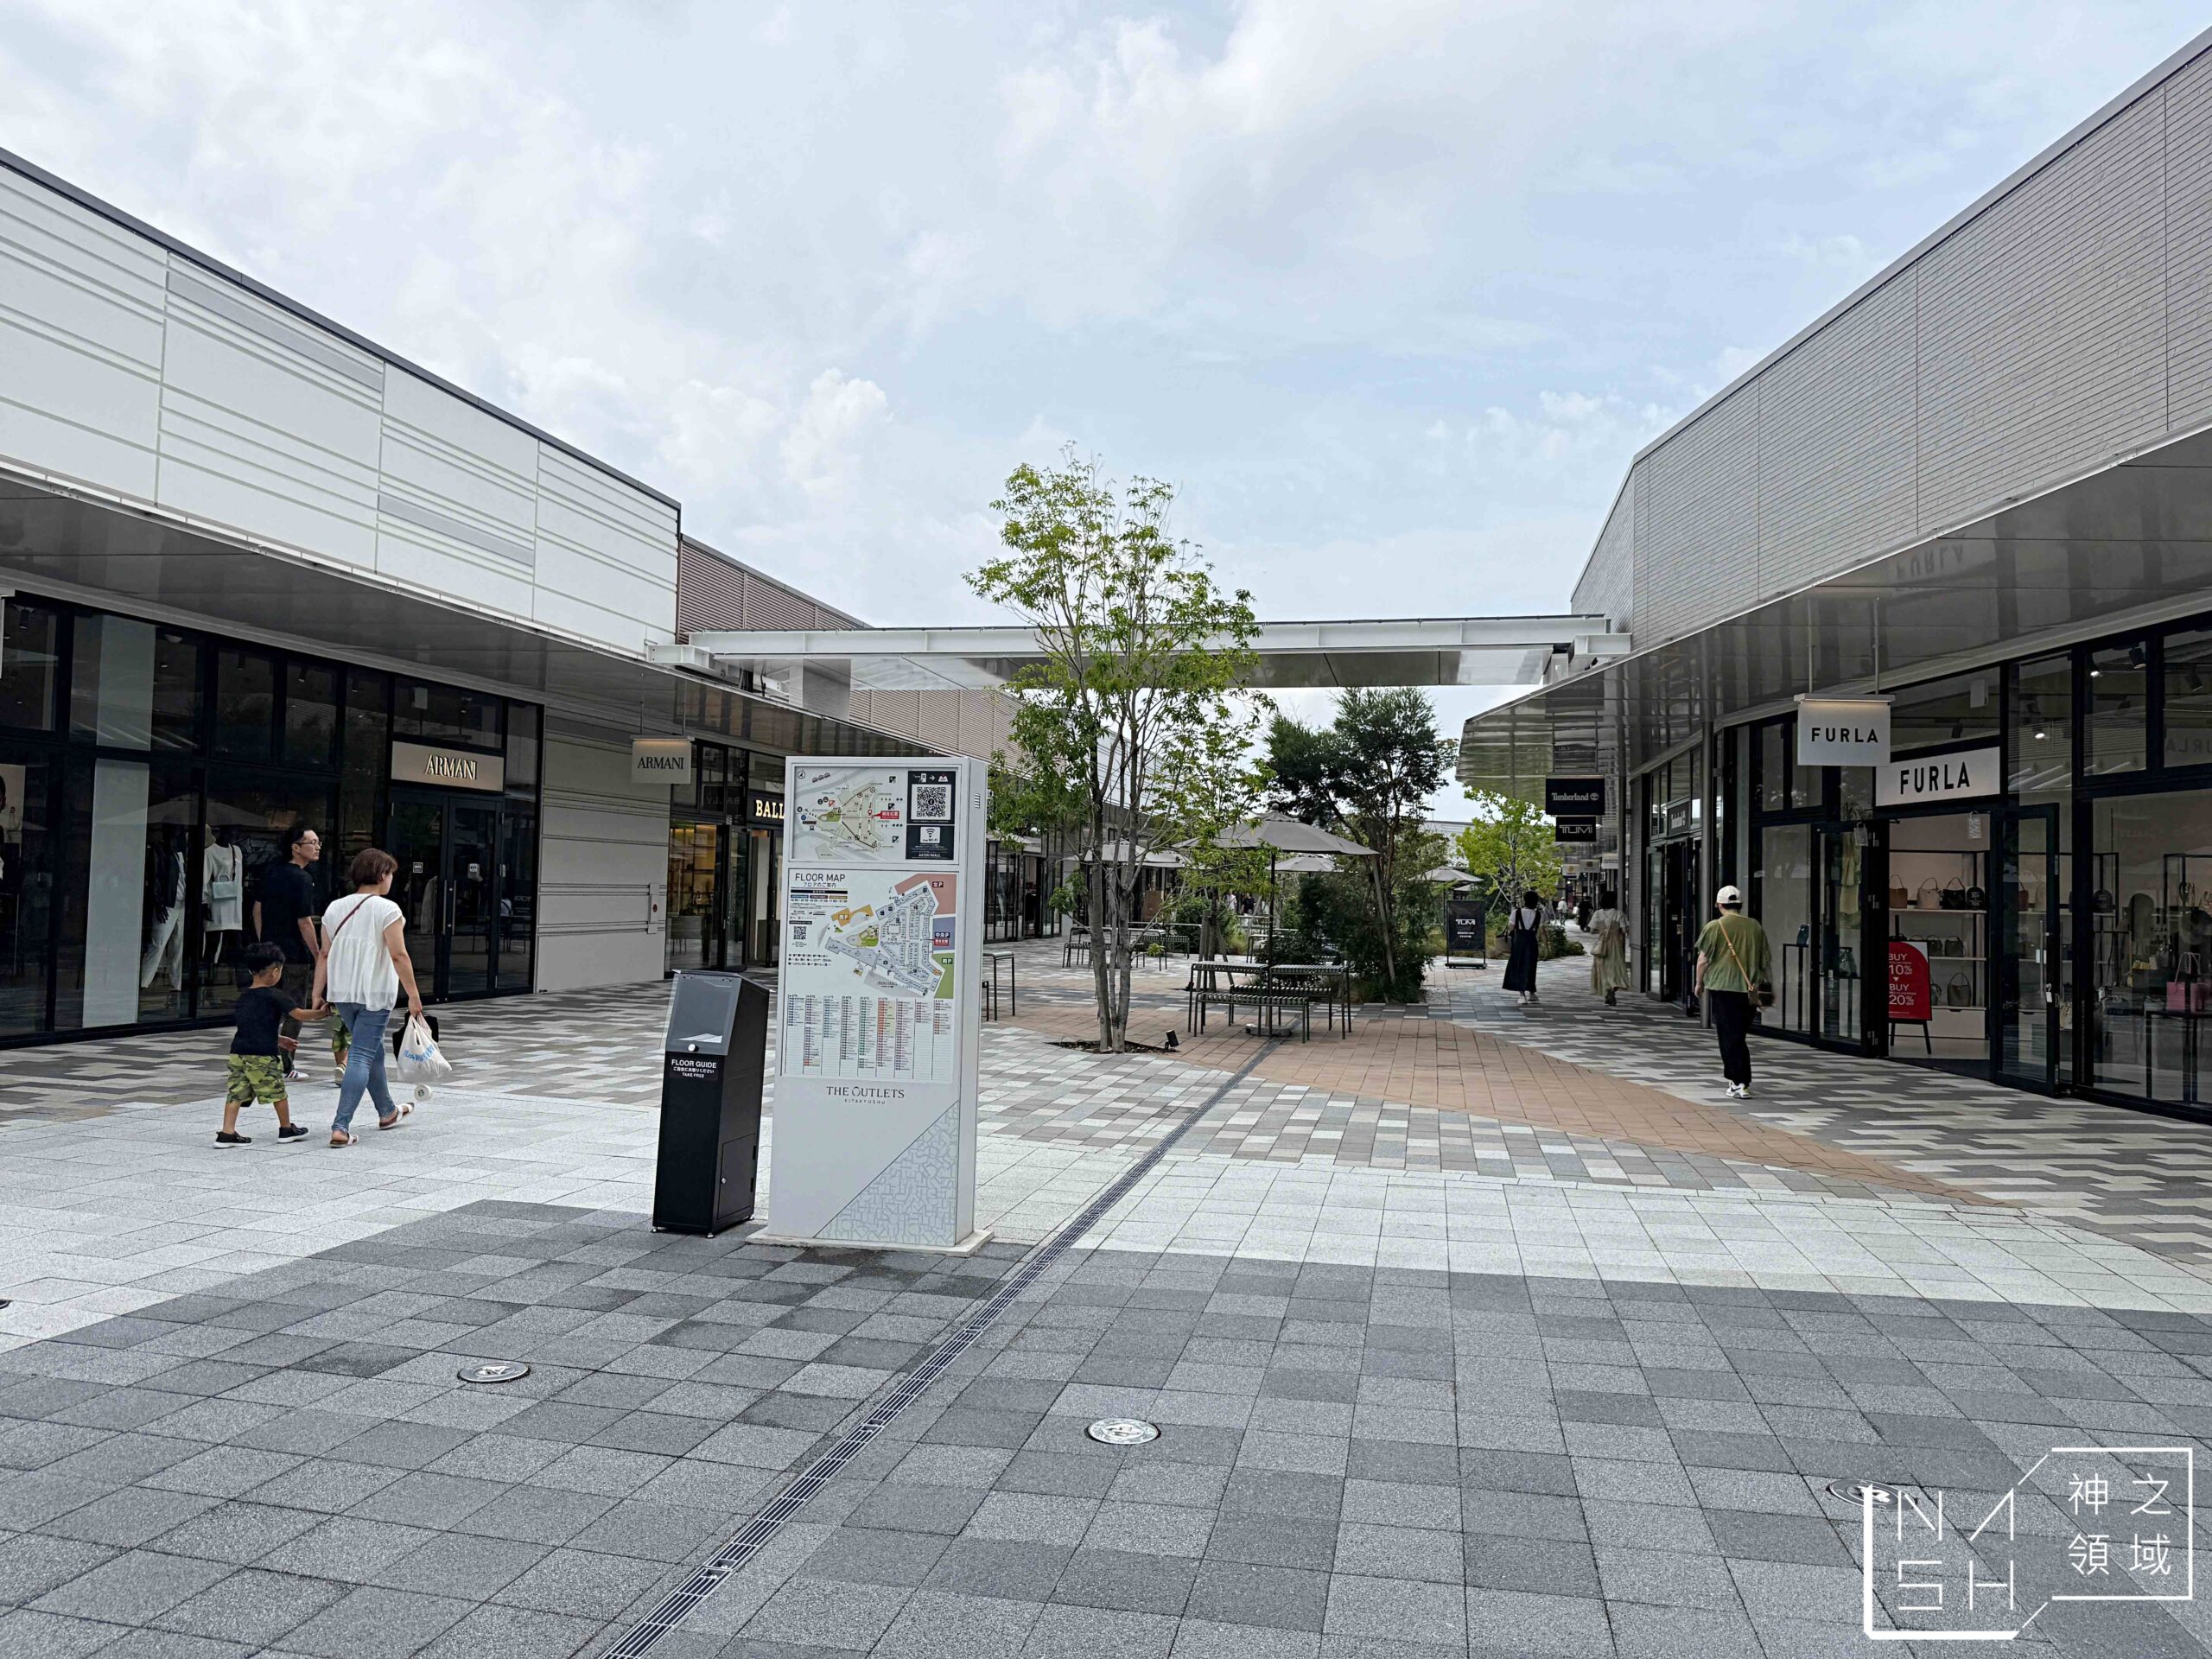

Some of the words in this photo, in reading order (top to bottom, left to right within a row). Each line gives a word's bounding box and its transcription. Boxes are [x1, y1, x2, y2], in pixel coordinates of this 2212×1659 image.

[1811, 727, 1878, 743] FURLA
[425, 753, 478, 780] ARMANI
[637, 756, 684, 770] ARMANI
[1900, 761, 1970, 795] FURLA
[1551, 792, 1589, 801] Timberland
[1559, 824, 1592, 834] TUMI
[795, 873, 823, 881] FLOOR
[671, 1058, 695, 1067] FLOOR
[826, 1086, 849, 1096] THE
[851, 1086, 905, 1098] OUTLETS
